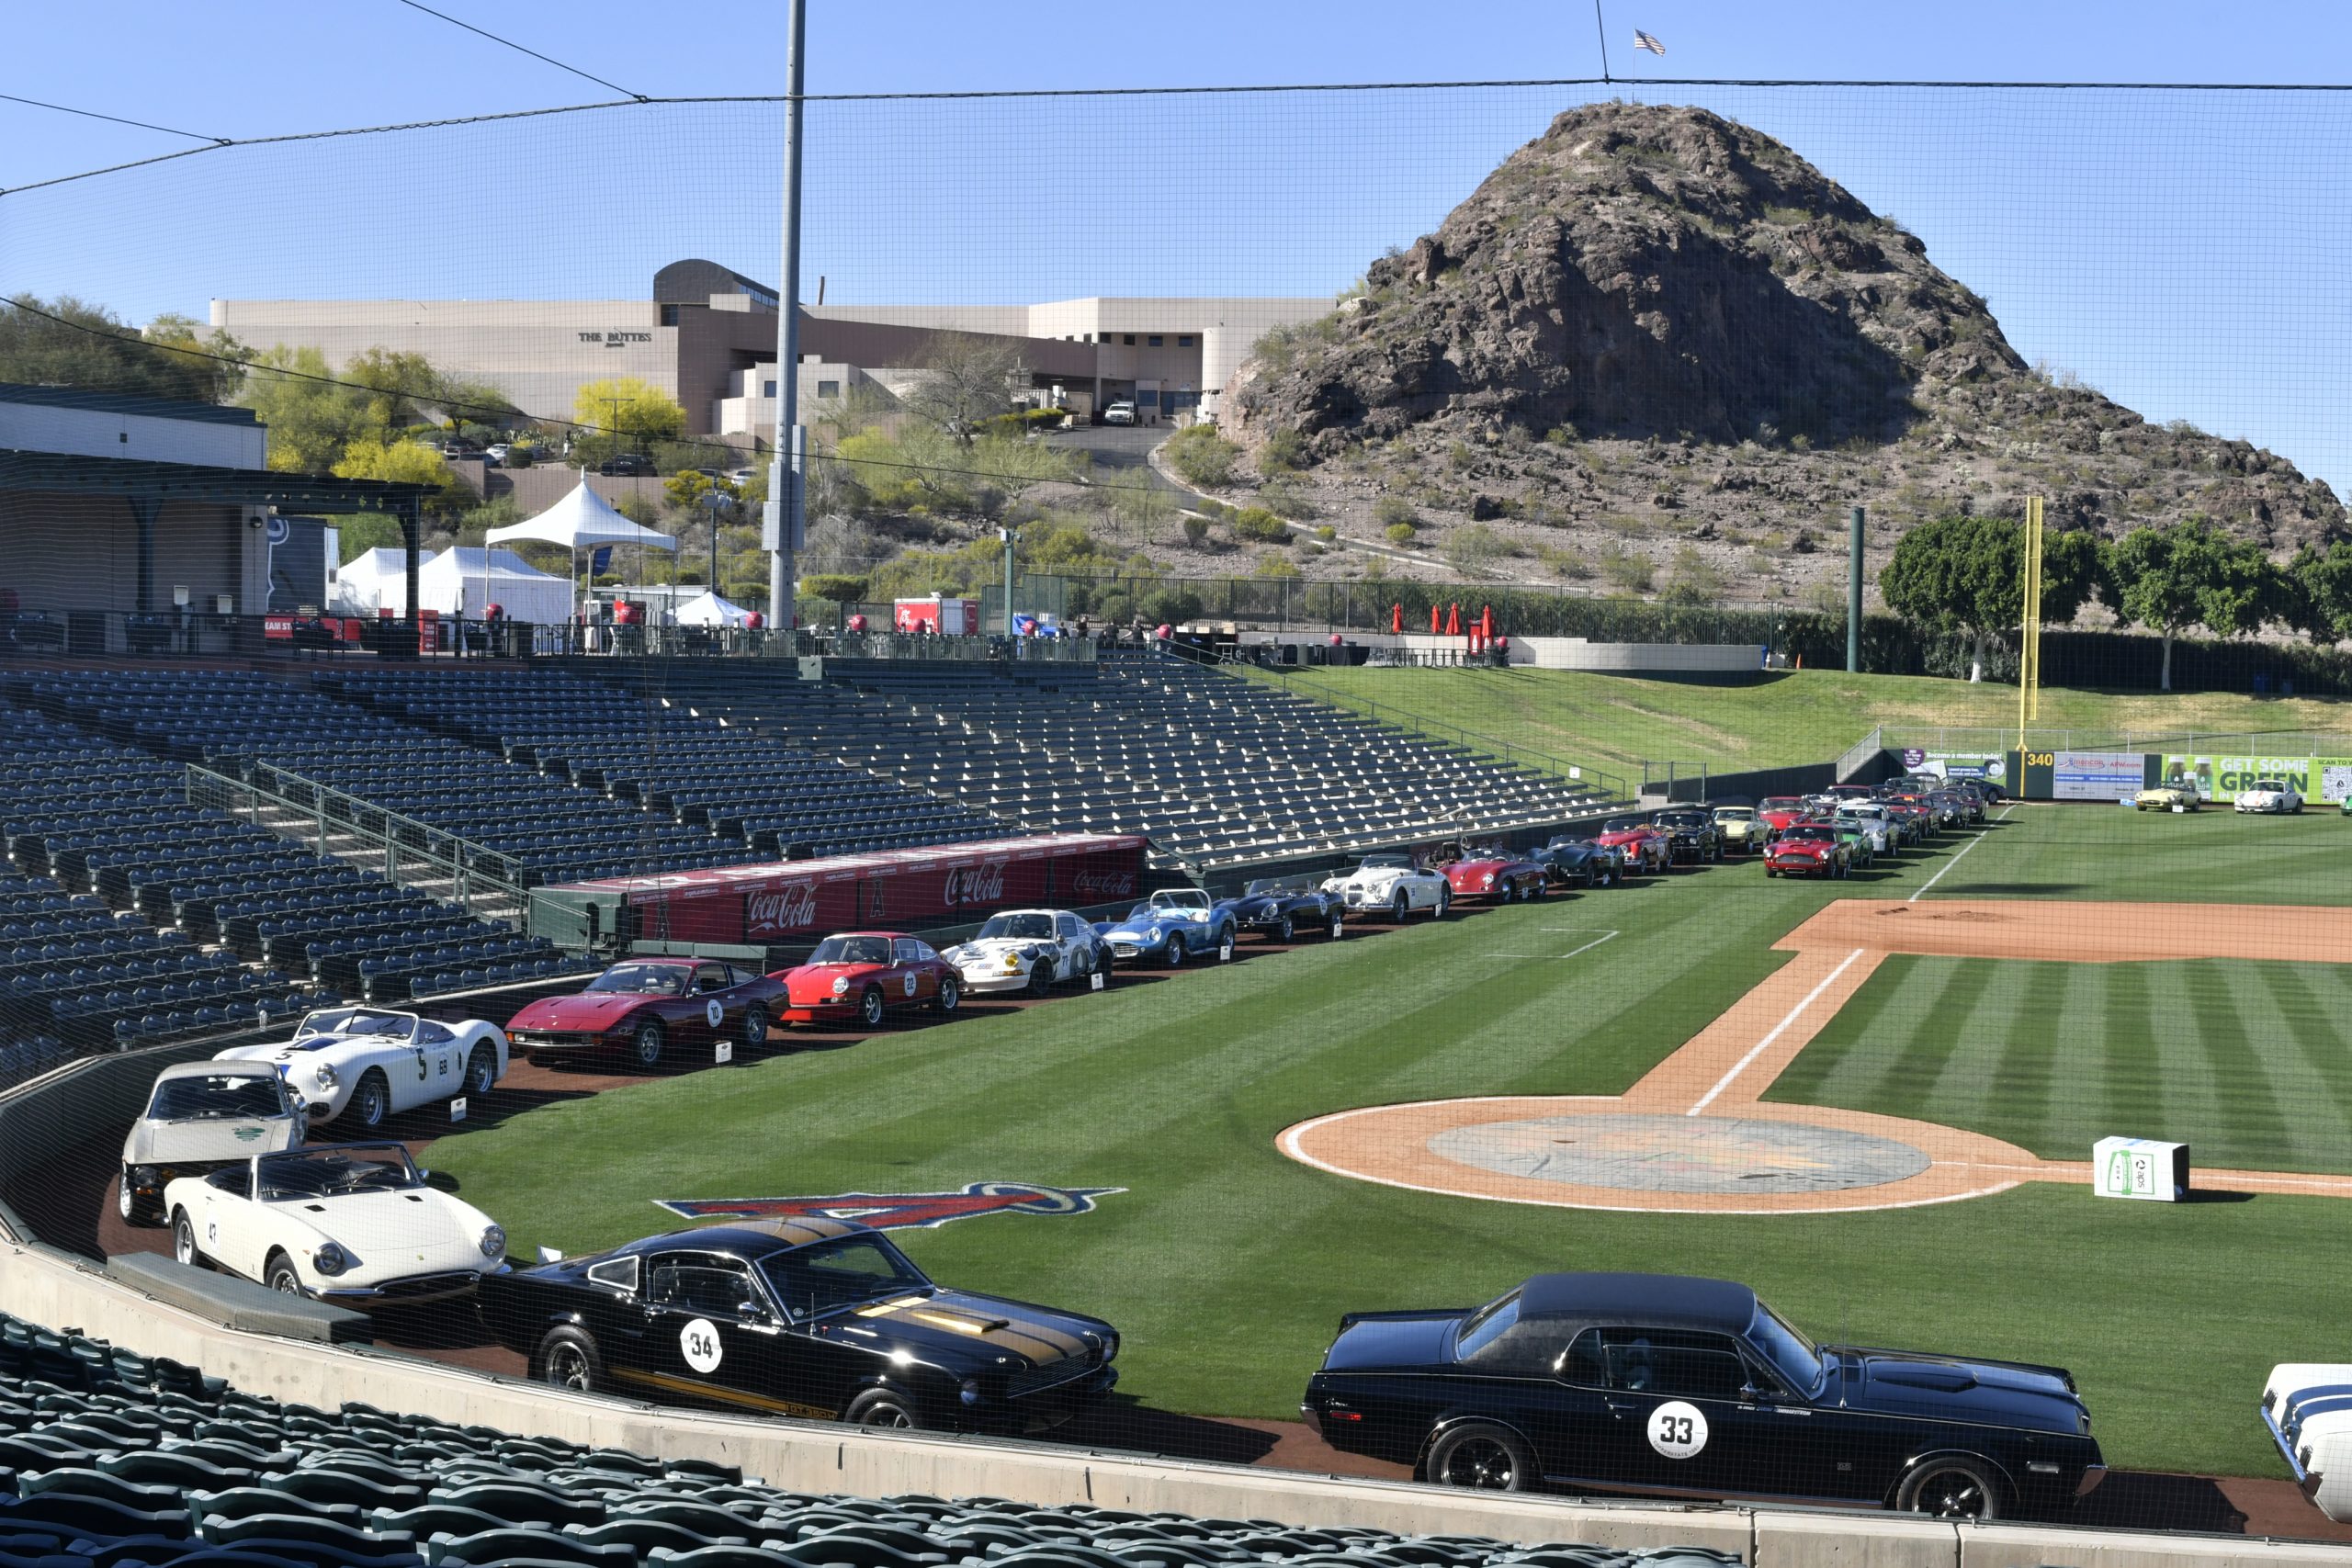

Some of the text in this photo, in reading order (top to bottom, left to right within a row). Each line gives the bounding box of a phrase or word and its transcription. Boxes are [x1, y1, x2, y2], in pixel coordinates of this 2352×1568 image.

[578, 333, 651, 342] THE BUTTES
[265, 621, 281, 630] EAM
[1983, 752, 2002, 761] today!
[2027, 753, 2053, 766] 340
[2220, 758, 2308, 773] GET SOME
[2219, 791, 2230, 800] IN
[1073, 869, 1136, 894] Coca-Cola
[1062, 954, 1069, 967] 77
[906, 977, 914, 990] 22
[710, 1006, 719, 1021] 10
[415, 1048, 427, 1081] 5
[2135, 1171, 2145, 1189] aps
[690, 1332, 713, 1359] 34
[1660, 1416, 1693, 1445] 33
[1654, 1440, 1688, 1457] COPPERSTATE
